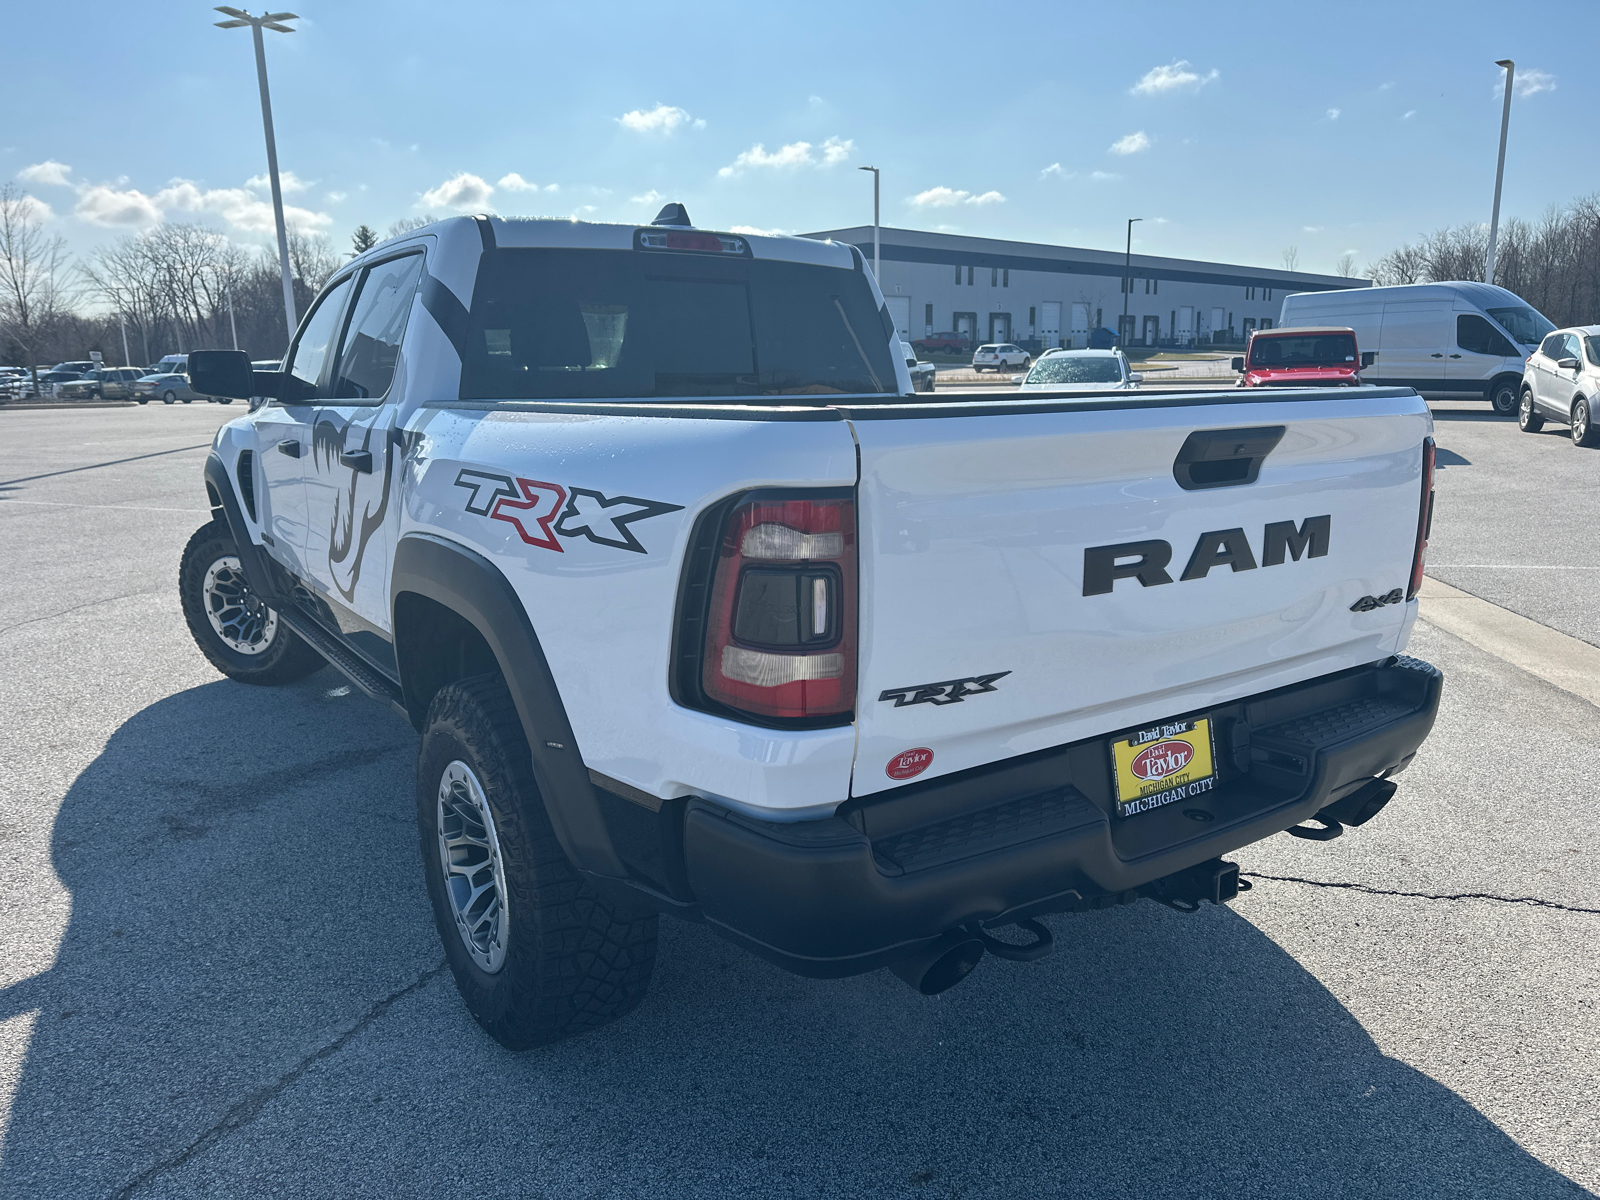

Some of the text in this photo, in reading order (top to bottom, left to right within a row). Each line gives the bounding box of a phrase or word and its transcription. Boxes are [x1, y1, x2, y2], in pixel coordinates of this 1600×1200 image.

[453, 468, 686, 555] TRX
[1082, 514, 1331, 597] RAM
[878, 670, 1013, 708] TRX
[1138, 722, 1187, 742] David Taylor
[897, 753, 929, 768] Taylor
[1141, 750, 1188, 779] Taylor
[1147, 745, 1165, 758] David
[1124, 777, 1214, 816] MICHIGAN CITY
[1140, 772, 1191, 796] MICHIGAN CITY
